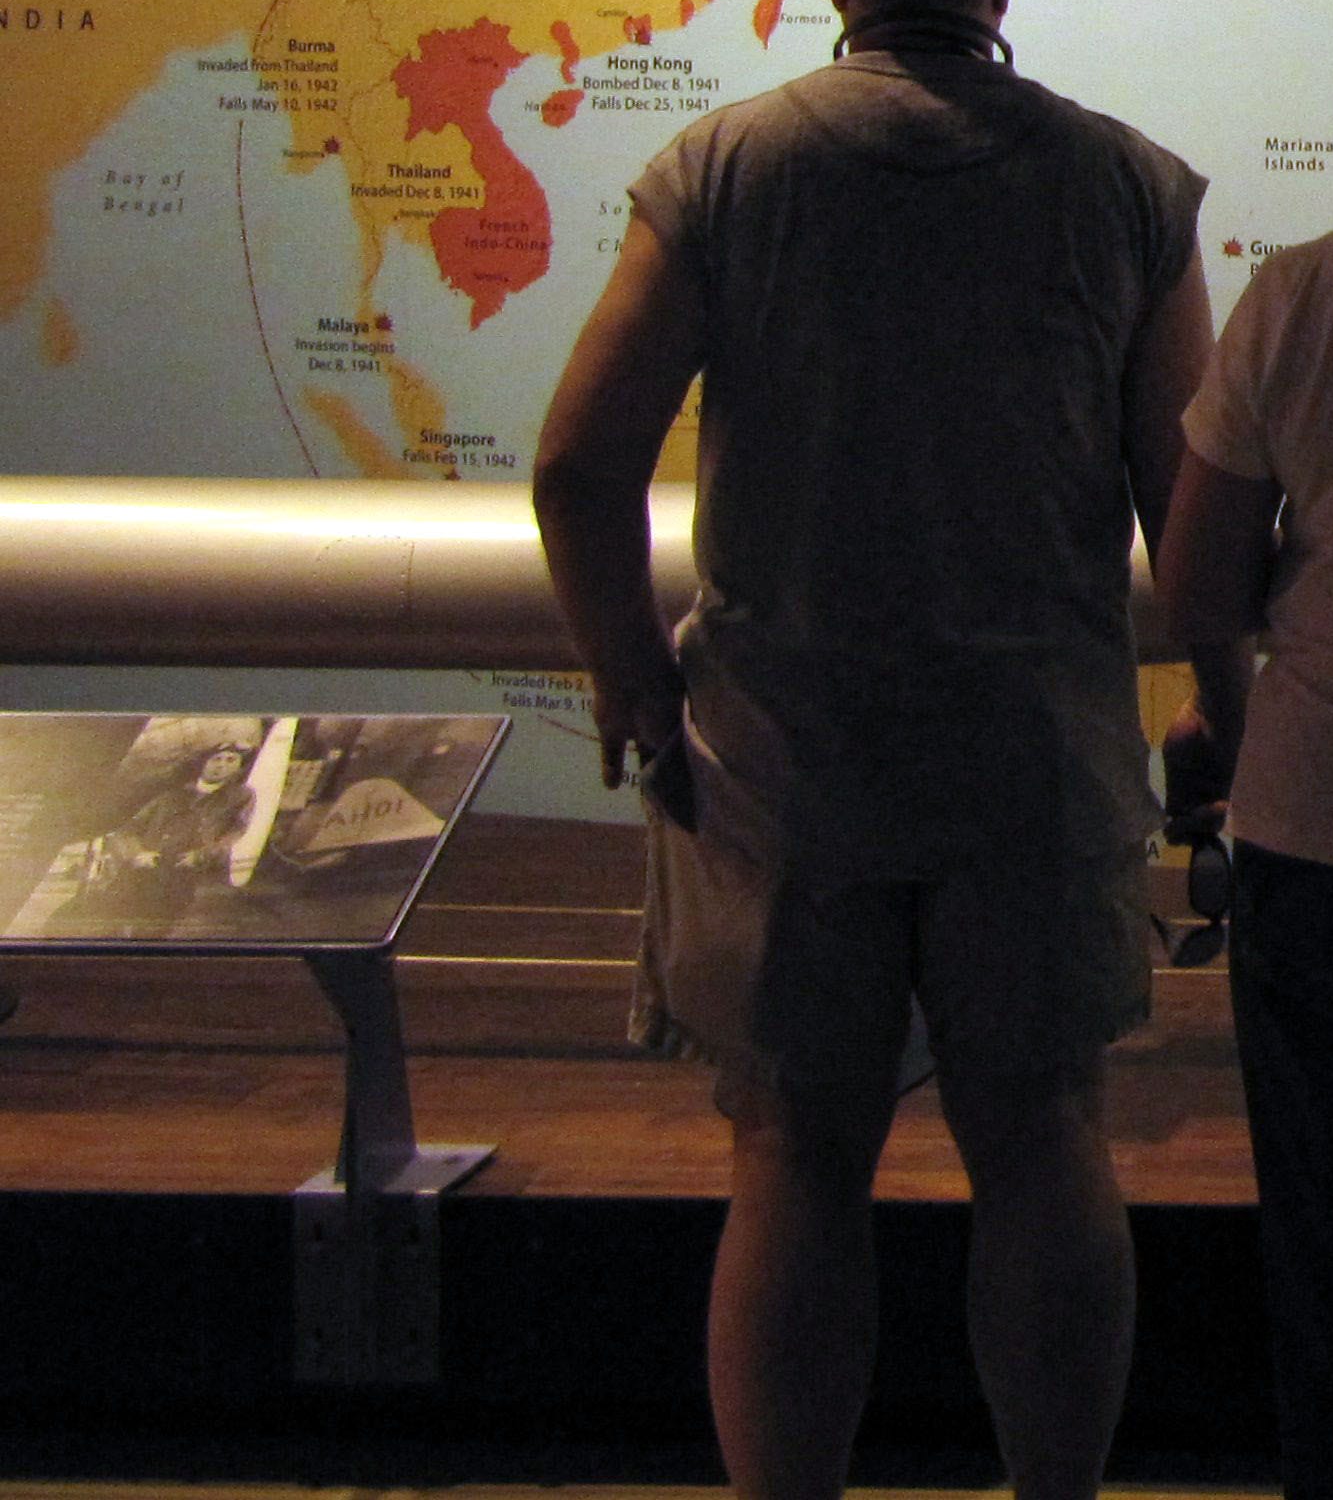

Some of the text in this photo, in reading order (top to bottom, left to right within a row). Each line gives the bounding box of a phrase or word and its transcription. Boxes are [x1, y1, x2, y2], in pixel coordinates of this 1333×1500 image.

[606, 55, 693, 76] Hong Kong
[582, 76, 720, 92] Bombed Dec 8, 1941
[591, 95, 711, 113] Falls Dec 25, 1941
[419, 429, 496, 450] Singapore
